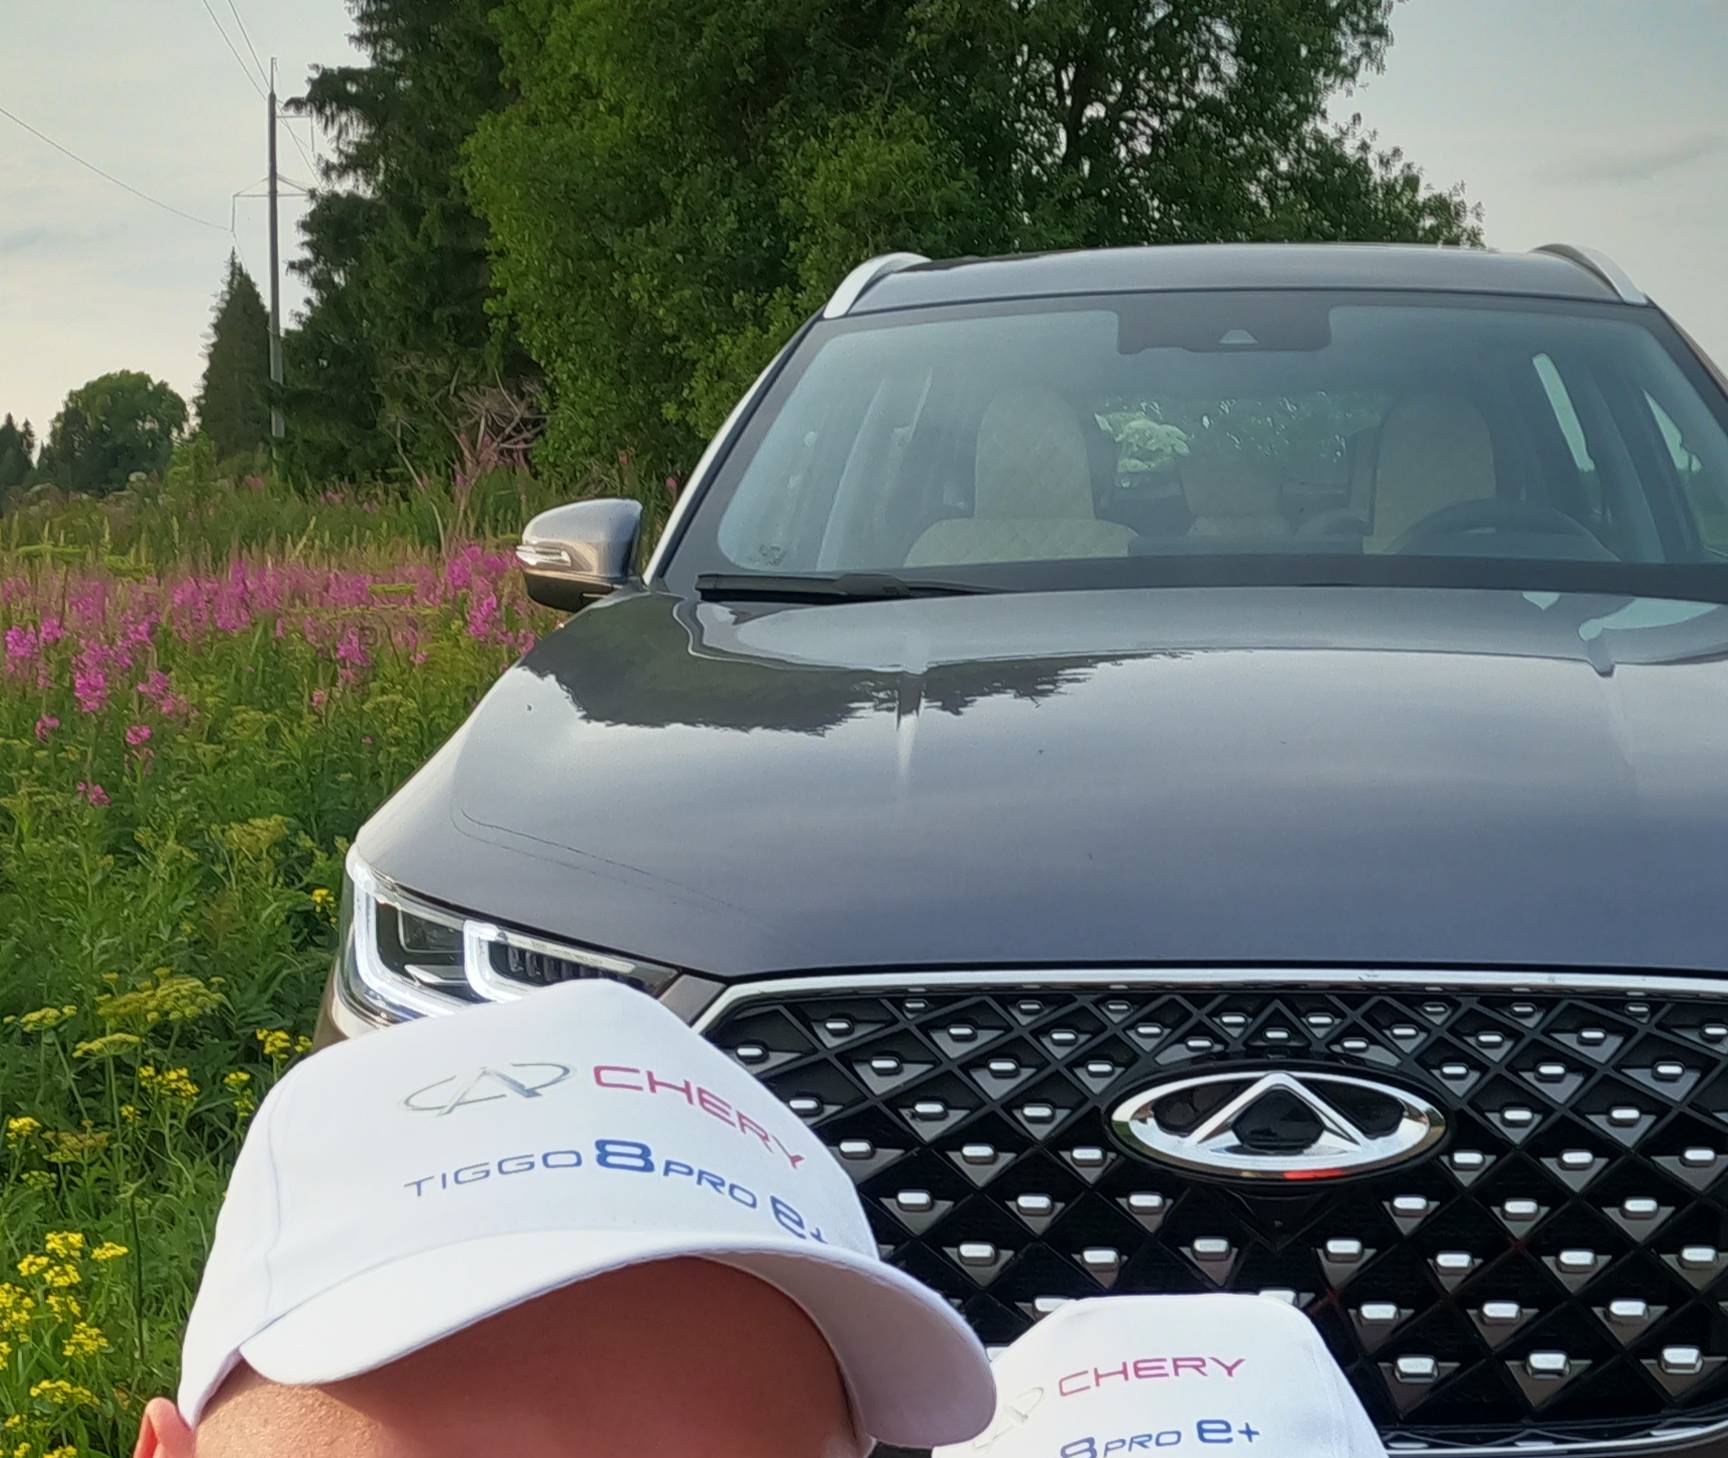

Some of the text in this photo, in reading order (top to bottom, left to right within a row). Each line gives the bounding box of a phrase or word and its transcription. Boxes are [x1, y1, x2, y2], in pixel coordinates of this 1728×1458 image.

[592, 1063, 807, 1170] CHERY
[404, 1148, 583, 1199] TIGGO
[595, 1138, 656, 1174] 8
[661, 1160, 758, 1211] PRO
[1057, 1355, 1246, 1399] CHERY
[1196, 1416, 1261, 1447] e+
